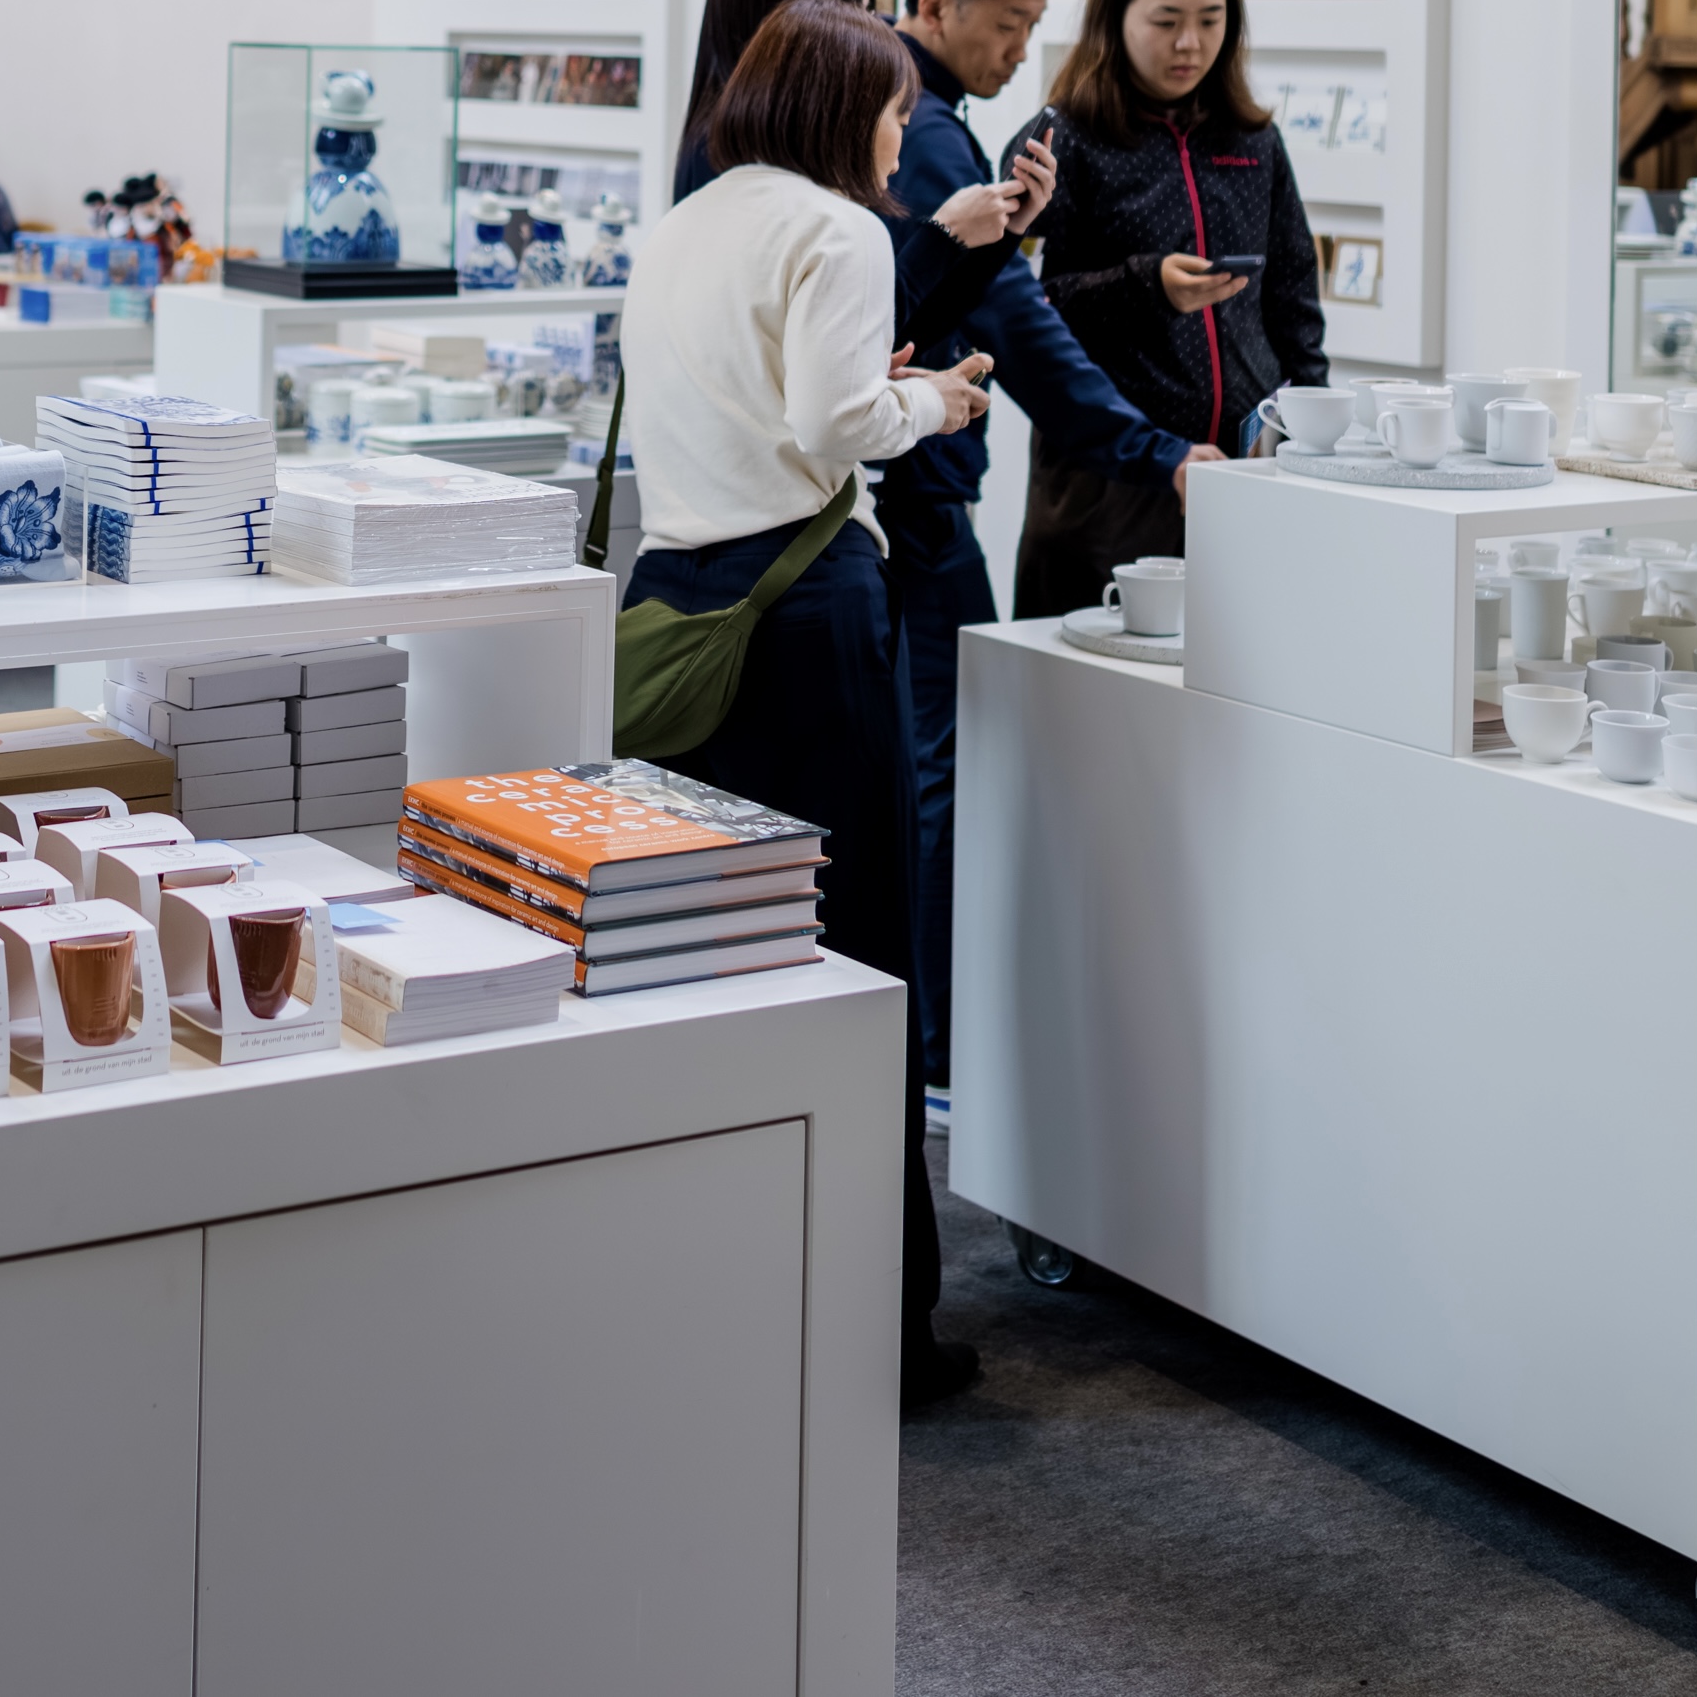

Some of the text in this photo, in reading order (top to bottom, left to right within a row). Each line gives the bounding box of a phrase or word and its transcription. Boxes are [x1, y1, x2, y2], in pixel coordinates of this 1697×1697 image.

[465, 774, 563, 789] the
[407, 795, 419, 806] EKWC
[466, 785, 592, 803] cera
[517, 795, 622, 813] mic
[544, 806, 646, 826] pro
[402, 823, 414, 835] EKWC
[551, 816, 679, 838] cess
[401, 856, 412, 867] EKWC
